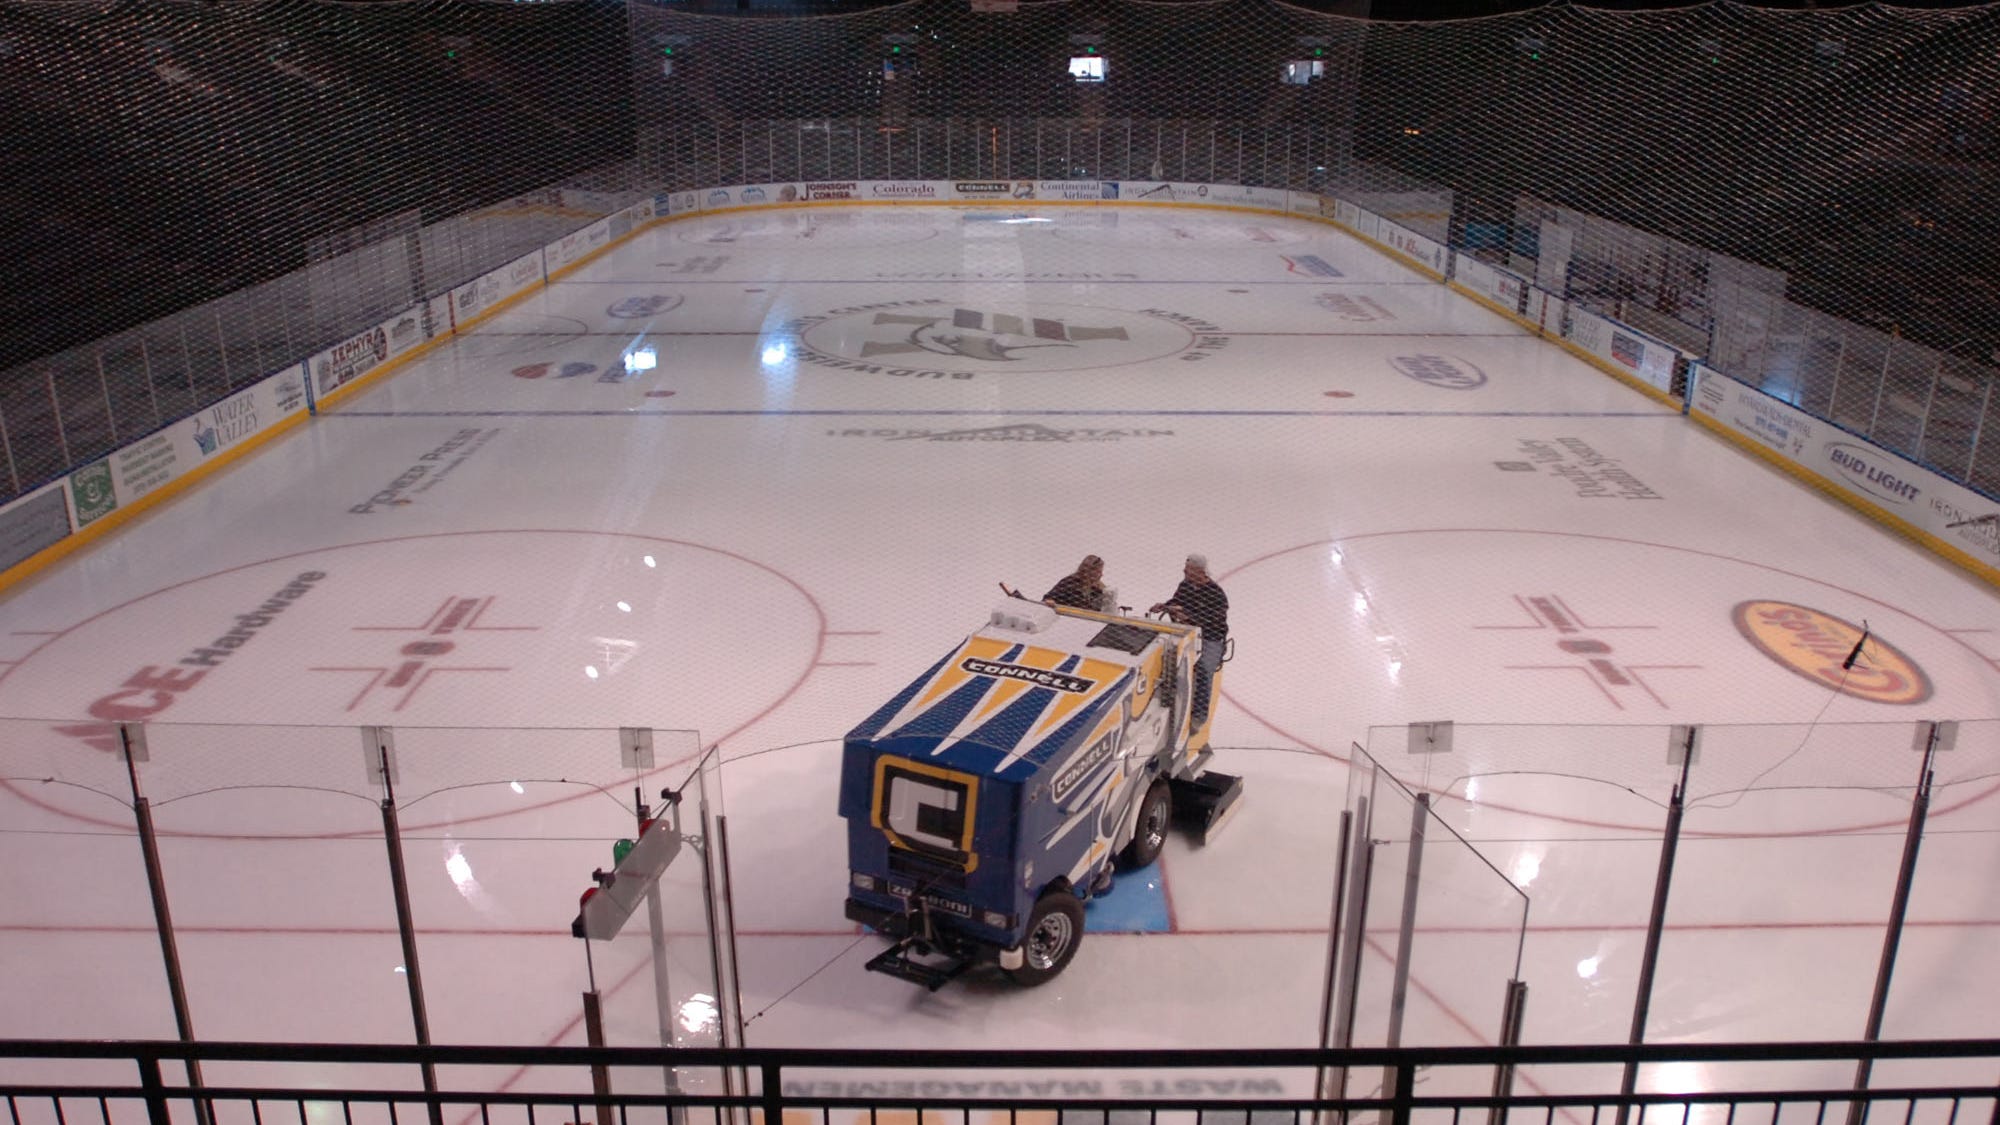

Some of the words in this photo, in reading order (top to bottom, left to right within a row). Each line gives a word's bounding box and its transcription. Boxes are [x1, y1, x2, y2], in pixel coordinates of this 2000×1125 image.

[873, 184, 915, 194] Colorado
[1040, 183, 1099, 191] Continental
[1063, 191, 1099, 200] Airlines
[331, 332, 375, 366] ZEPHYR
[788, 344, 975, 380] BUDWEISE
[213, 392, 255, 425] WATER
[216, 412, 257, 446] VALLEY
[826, 429, 931, 438] IRON
[1829, 448, 1867, 475] BUD
[1866, 466, 1920, 501] LIGHT
[1930, 499, 1962, 521] IRON
[180, 570, 326, 666] Hardware
[968, 662, 1084, 690] CONNELL
[1056, 739, 1110, 793] CONNELL
[891, 884, 968, 914] ZABONI
[780, 1077, 1104, 1098] MANAGEMEN
[1118, 1078, 1286, 1096] WASTE
